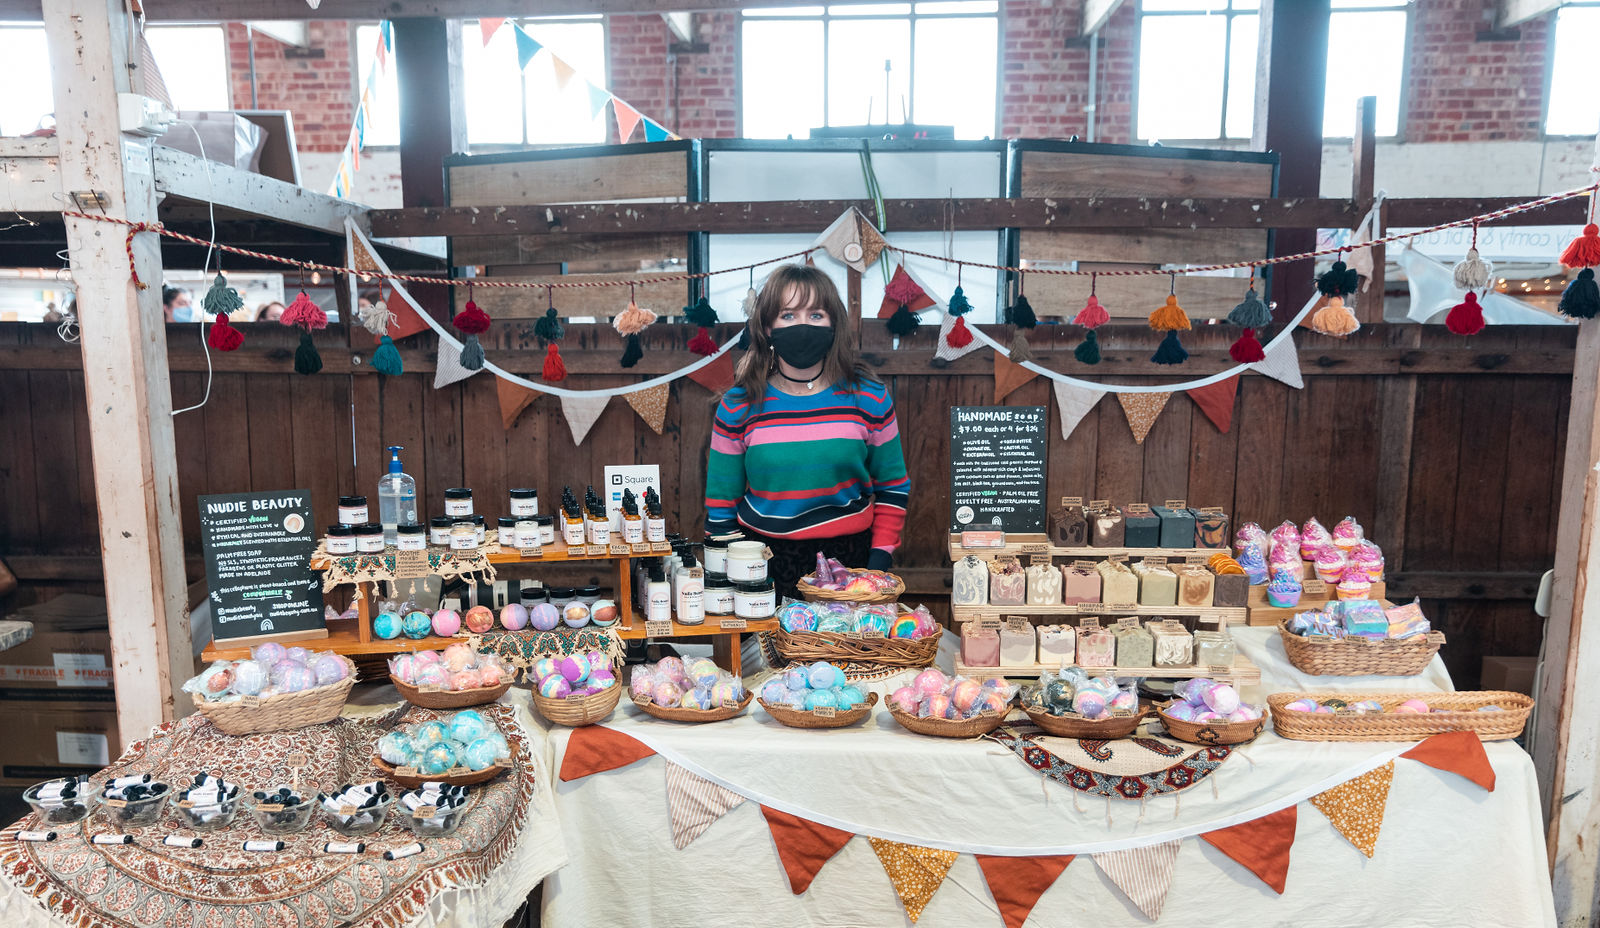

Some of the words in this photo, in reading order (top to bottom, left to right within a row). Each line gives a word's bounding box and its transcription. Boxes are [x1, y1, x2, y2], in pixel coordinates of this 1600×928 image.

[958, 411, 1012, 422] HANDMADE
[1014, 413, 1039, 421] soap
[984, 425, 999, 433] each
[1015, 425, 1024, 433] for
[624, 476, 653, 485] Square
[207, 501, 247, 514] NUDIE
[252, 498, 303, 510] BEAUTY
[215, 518, 247, 526] CERTIFIED
[216, 552, 233, 560] PALM
[287, 600, 309, 608] ONLINE
[22, 669, 65, 678] FRAGILE
[81, 669, 114, 678] FRAGI
